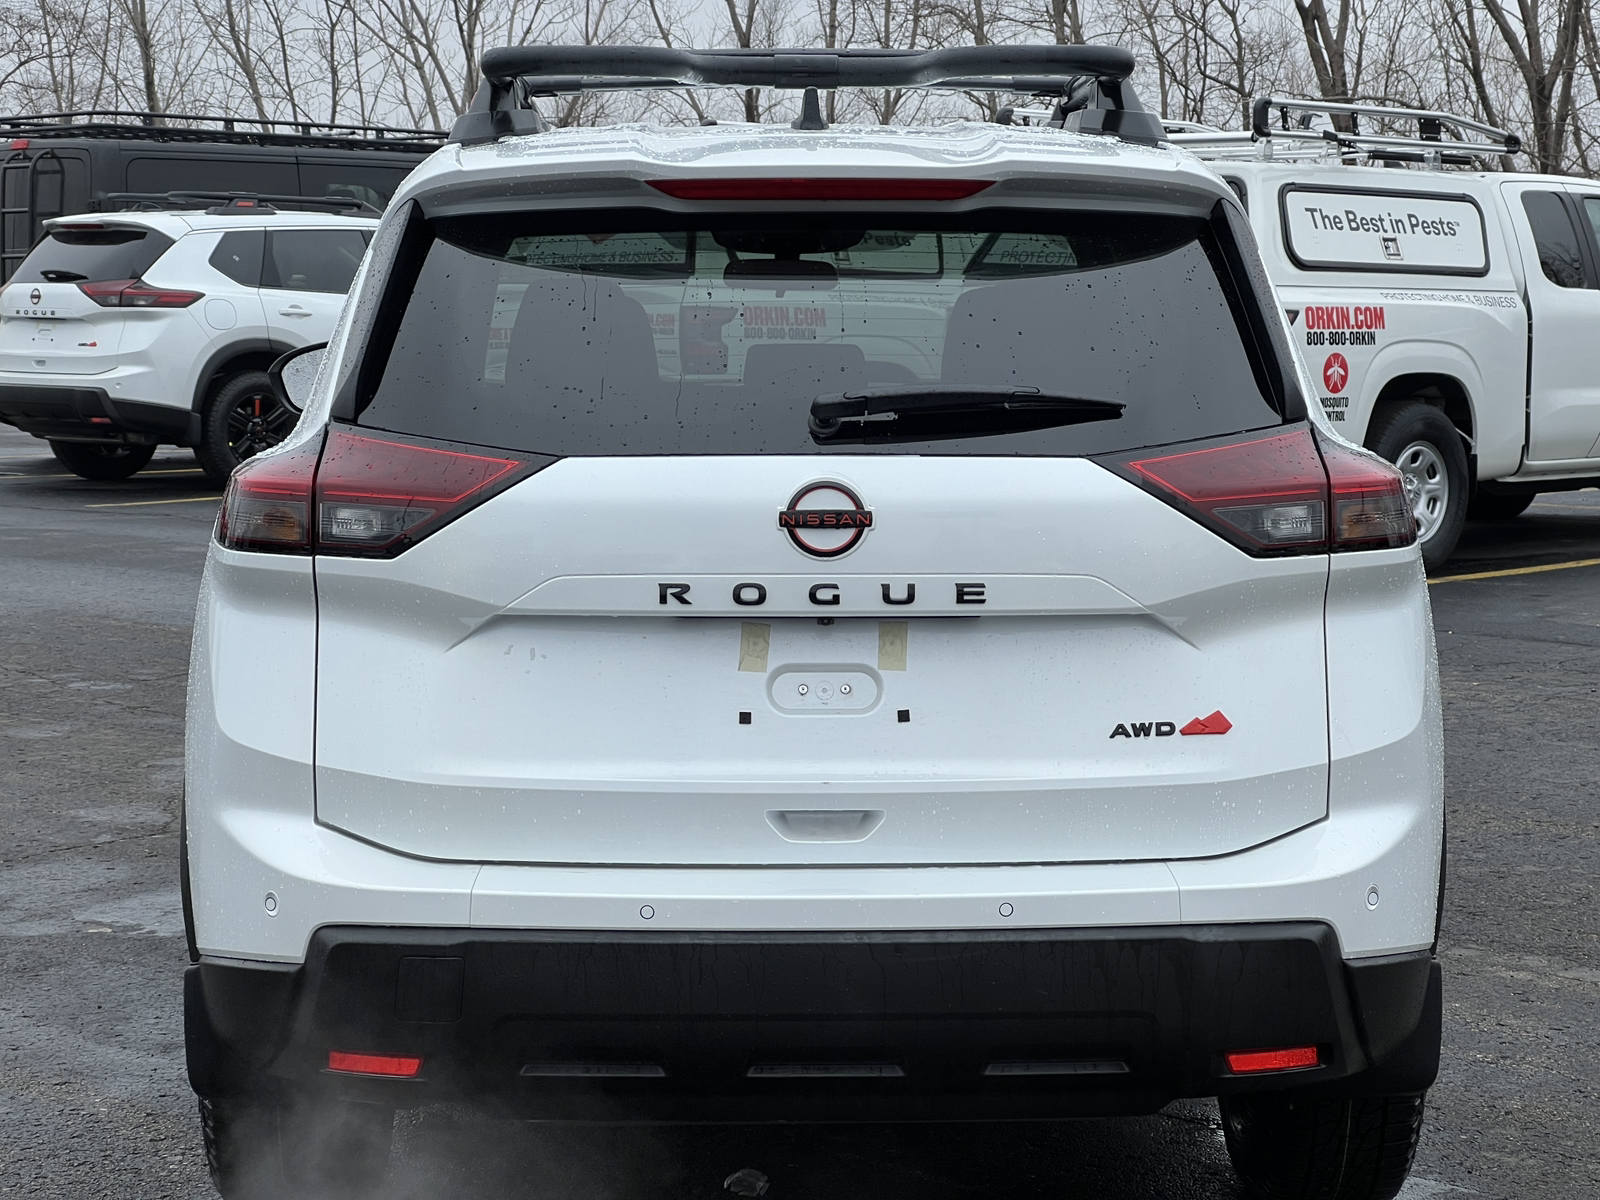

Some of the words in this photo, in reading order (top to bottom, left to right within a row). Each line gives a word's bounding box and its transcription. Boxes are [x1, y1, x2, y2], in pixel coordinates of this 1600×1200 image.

[1304, 207, 1344, 231] The
[1344, 209, 1388, 234] Best
[1387, 212, 1407, 234] in
[617, 250, 675, 263] BUSINESS
[1000, 250, 1076, 264] PROTECTIN
[1380, 292, 1442, 302] PROTECTING
[1441, 294, 1466, 303] HOME
[1474, 295, 1517, 309] BUSINESS
[743, 305, 827, 327] ORKIN.COM
[1305, 305, 1386, 330] ORKIN.COM
[744, 326, 817, 340] 800-800-ORKIN
[1306, 331, 1376, 346] 800-800-ORKIN
[781, 513, 870, 525] NISSAN
[658, 582, 987, 606] ROGUE
[1109, 721, 1176, 739] AWD
